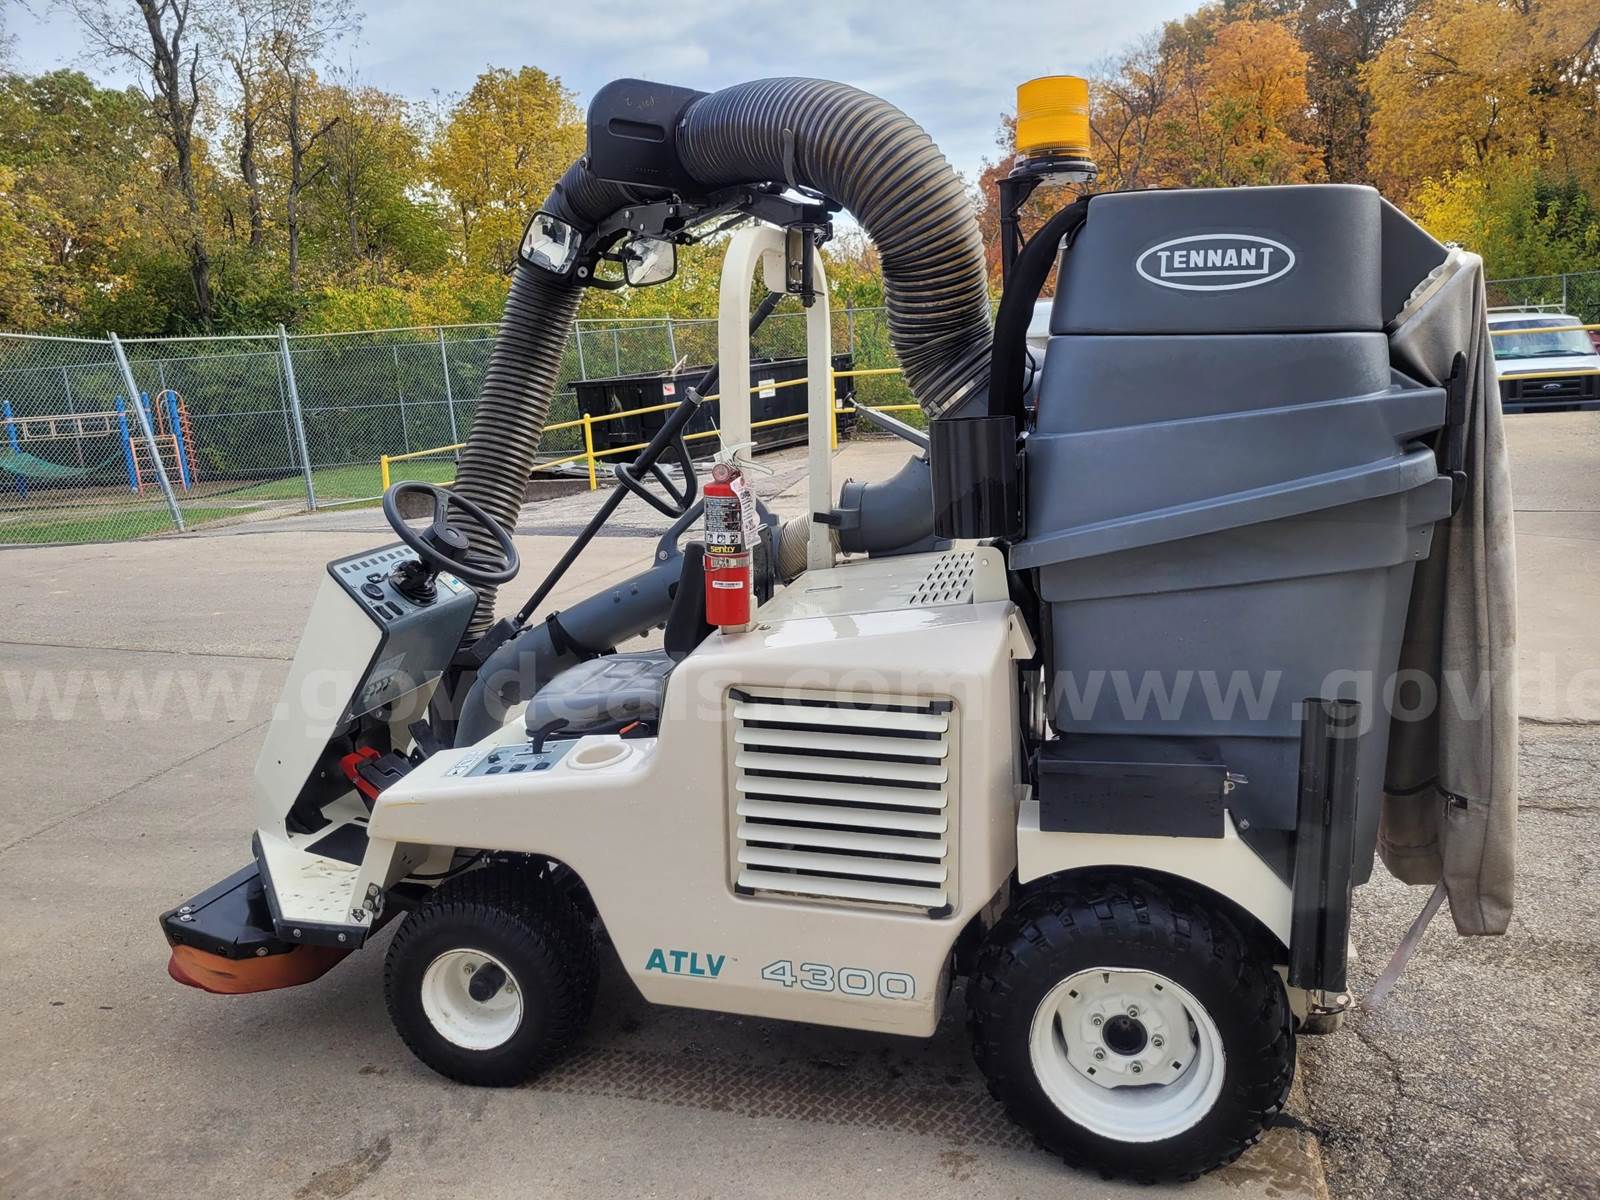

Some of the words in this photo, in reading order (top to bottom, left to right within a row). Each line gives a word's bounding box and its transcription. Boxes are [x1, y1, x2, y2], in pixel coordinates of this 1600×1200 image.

[1157, 248, 1273, 277] TENNANT
[645, 948, 725, 977] ATLV
[761, 960, 915, 1000] 4300
